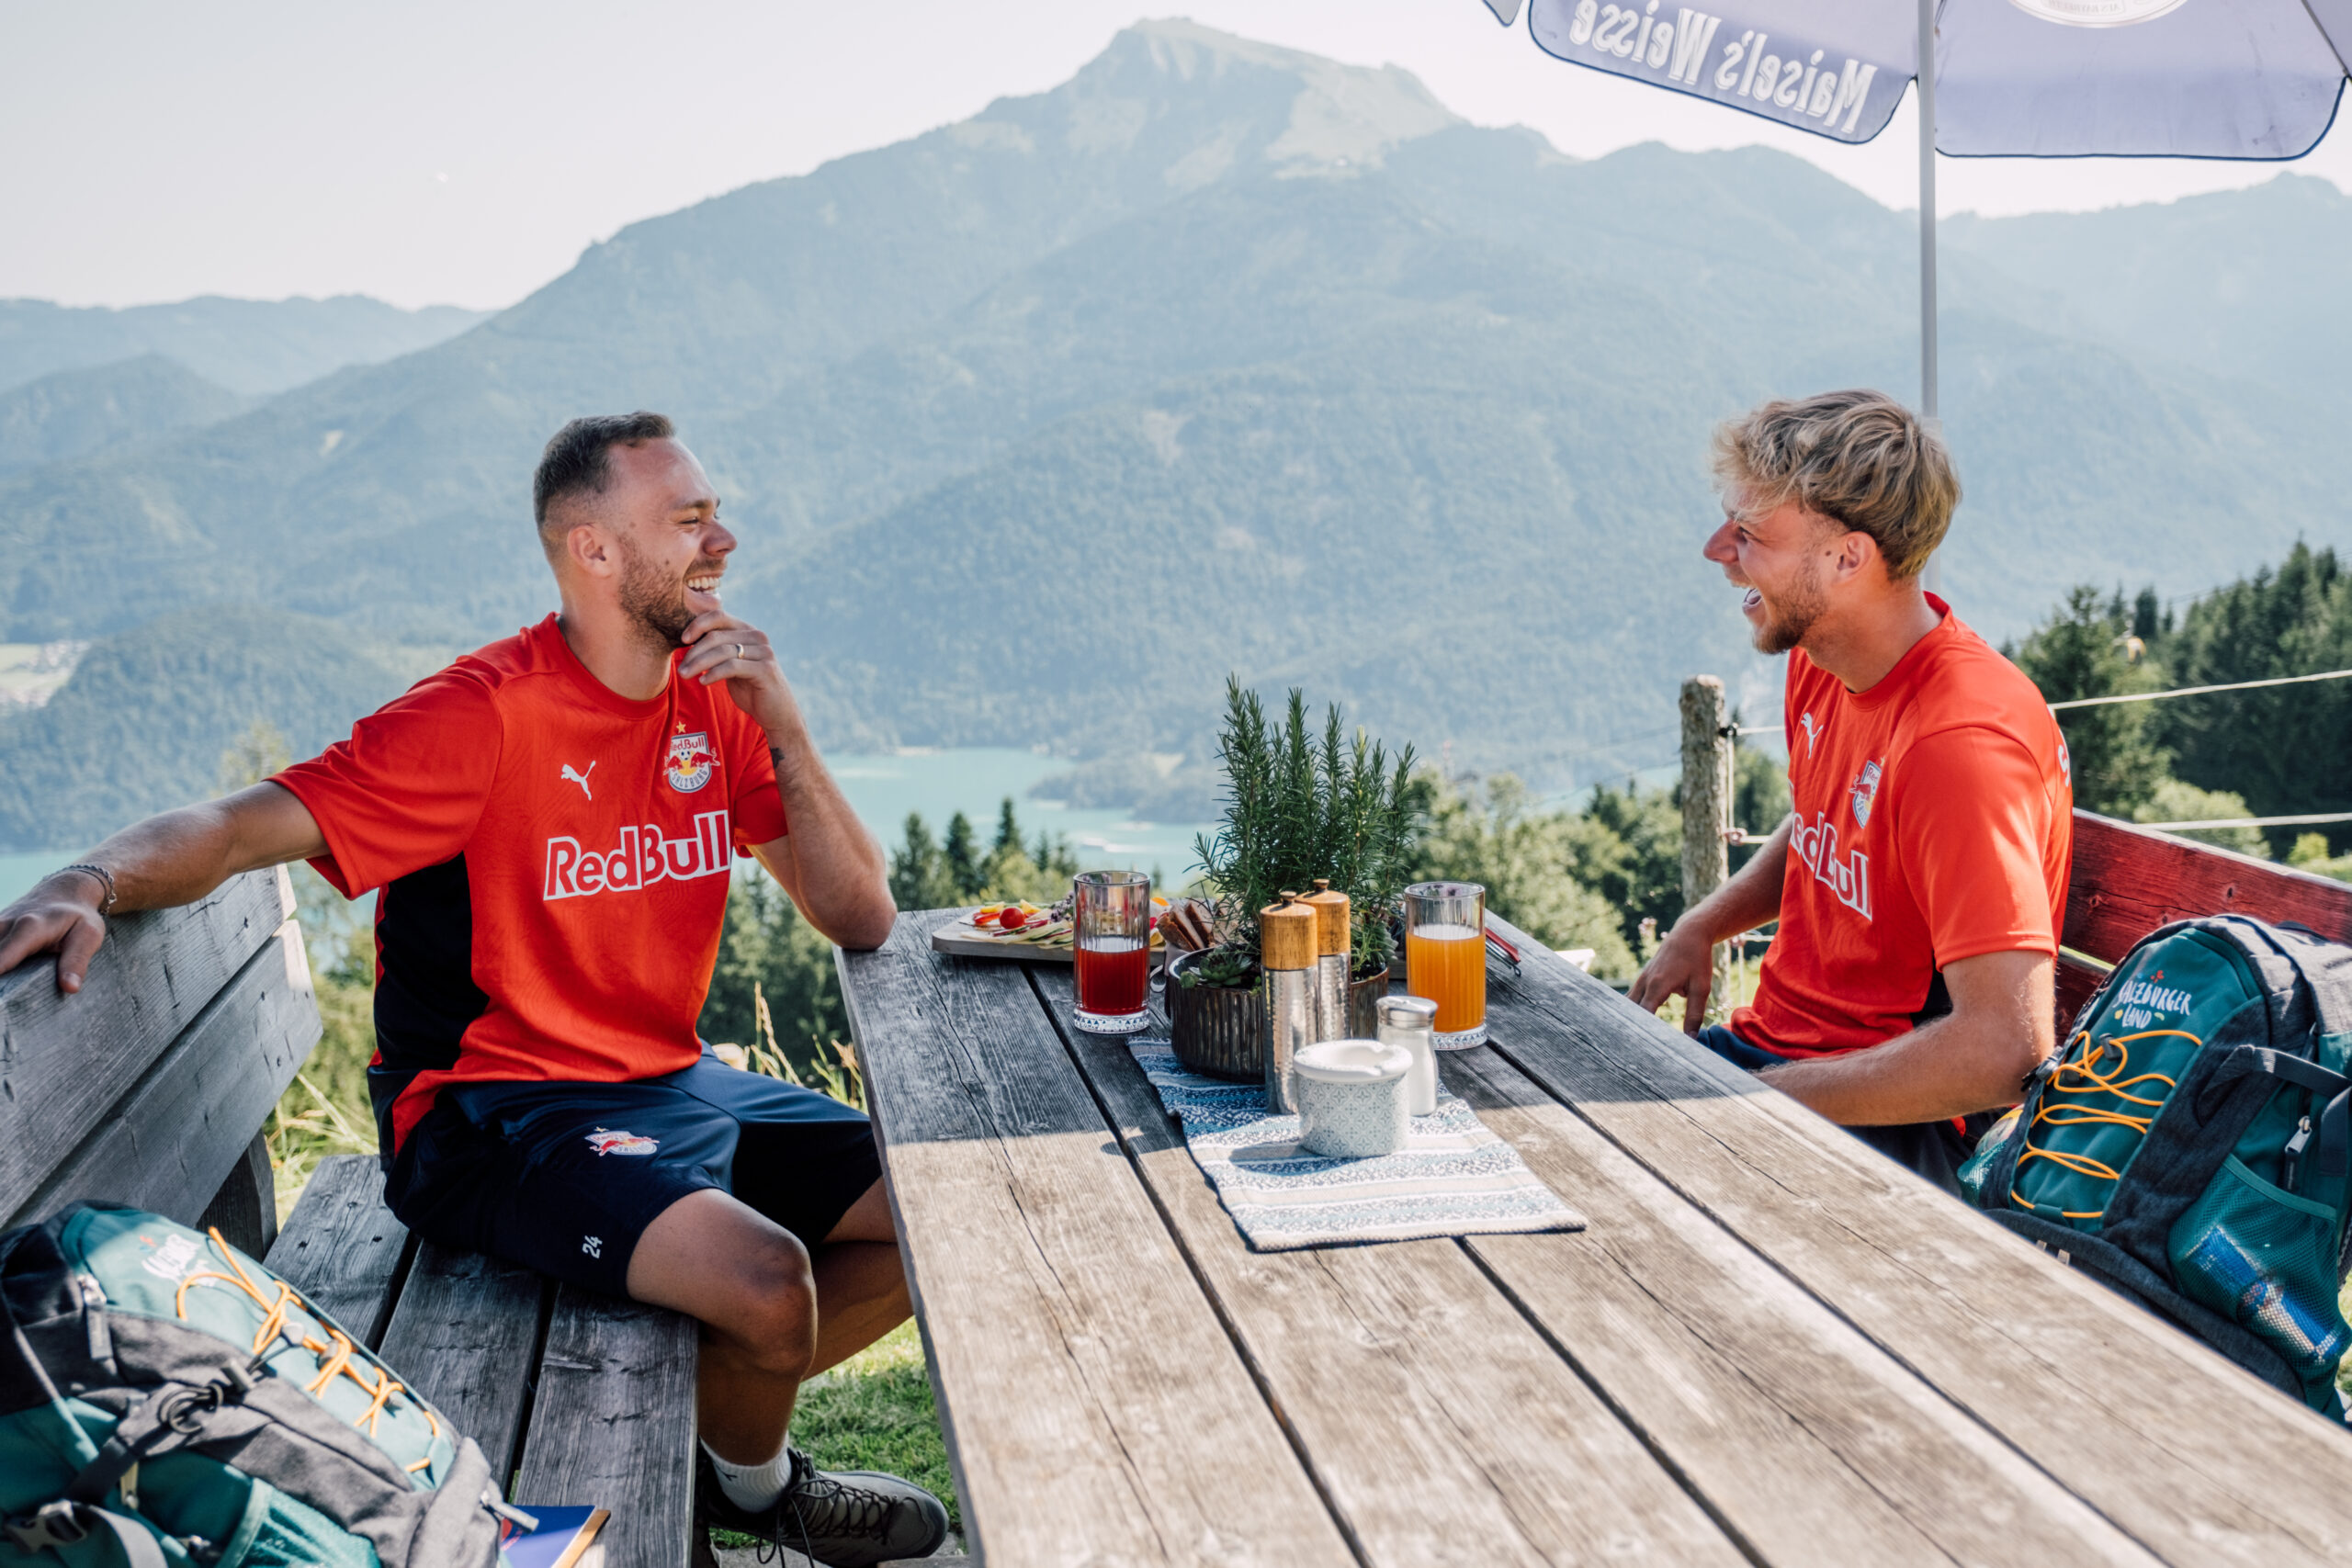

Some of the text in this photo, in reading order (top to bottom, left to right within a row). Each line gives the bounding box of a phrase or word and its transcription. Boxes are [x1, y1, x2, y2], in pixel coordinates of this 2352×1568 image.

[672, 768, 708, 788] SALZBURG
[2112, 980, 2191, 1016] SALZBURGER
[2121, 1003, 2152, 1029] LAND
[582, 1235, 603, 1259] 24
